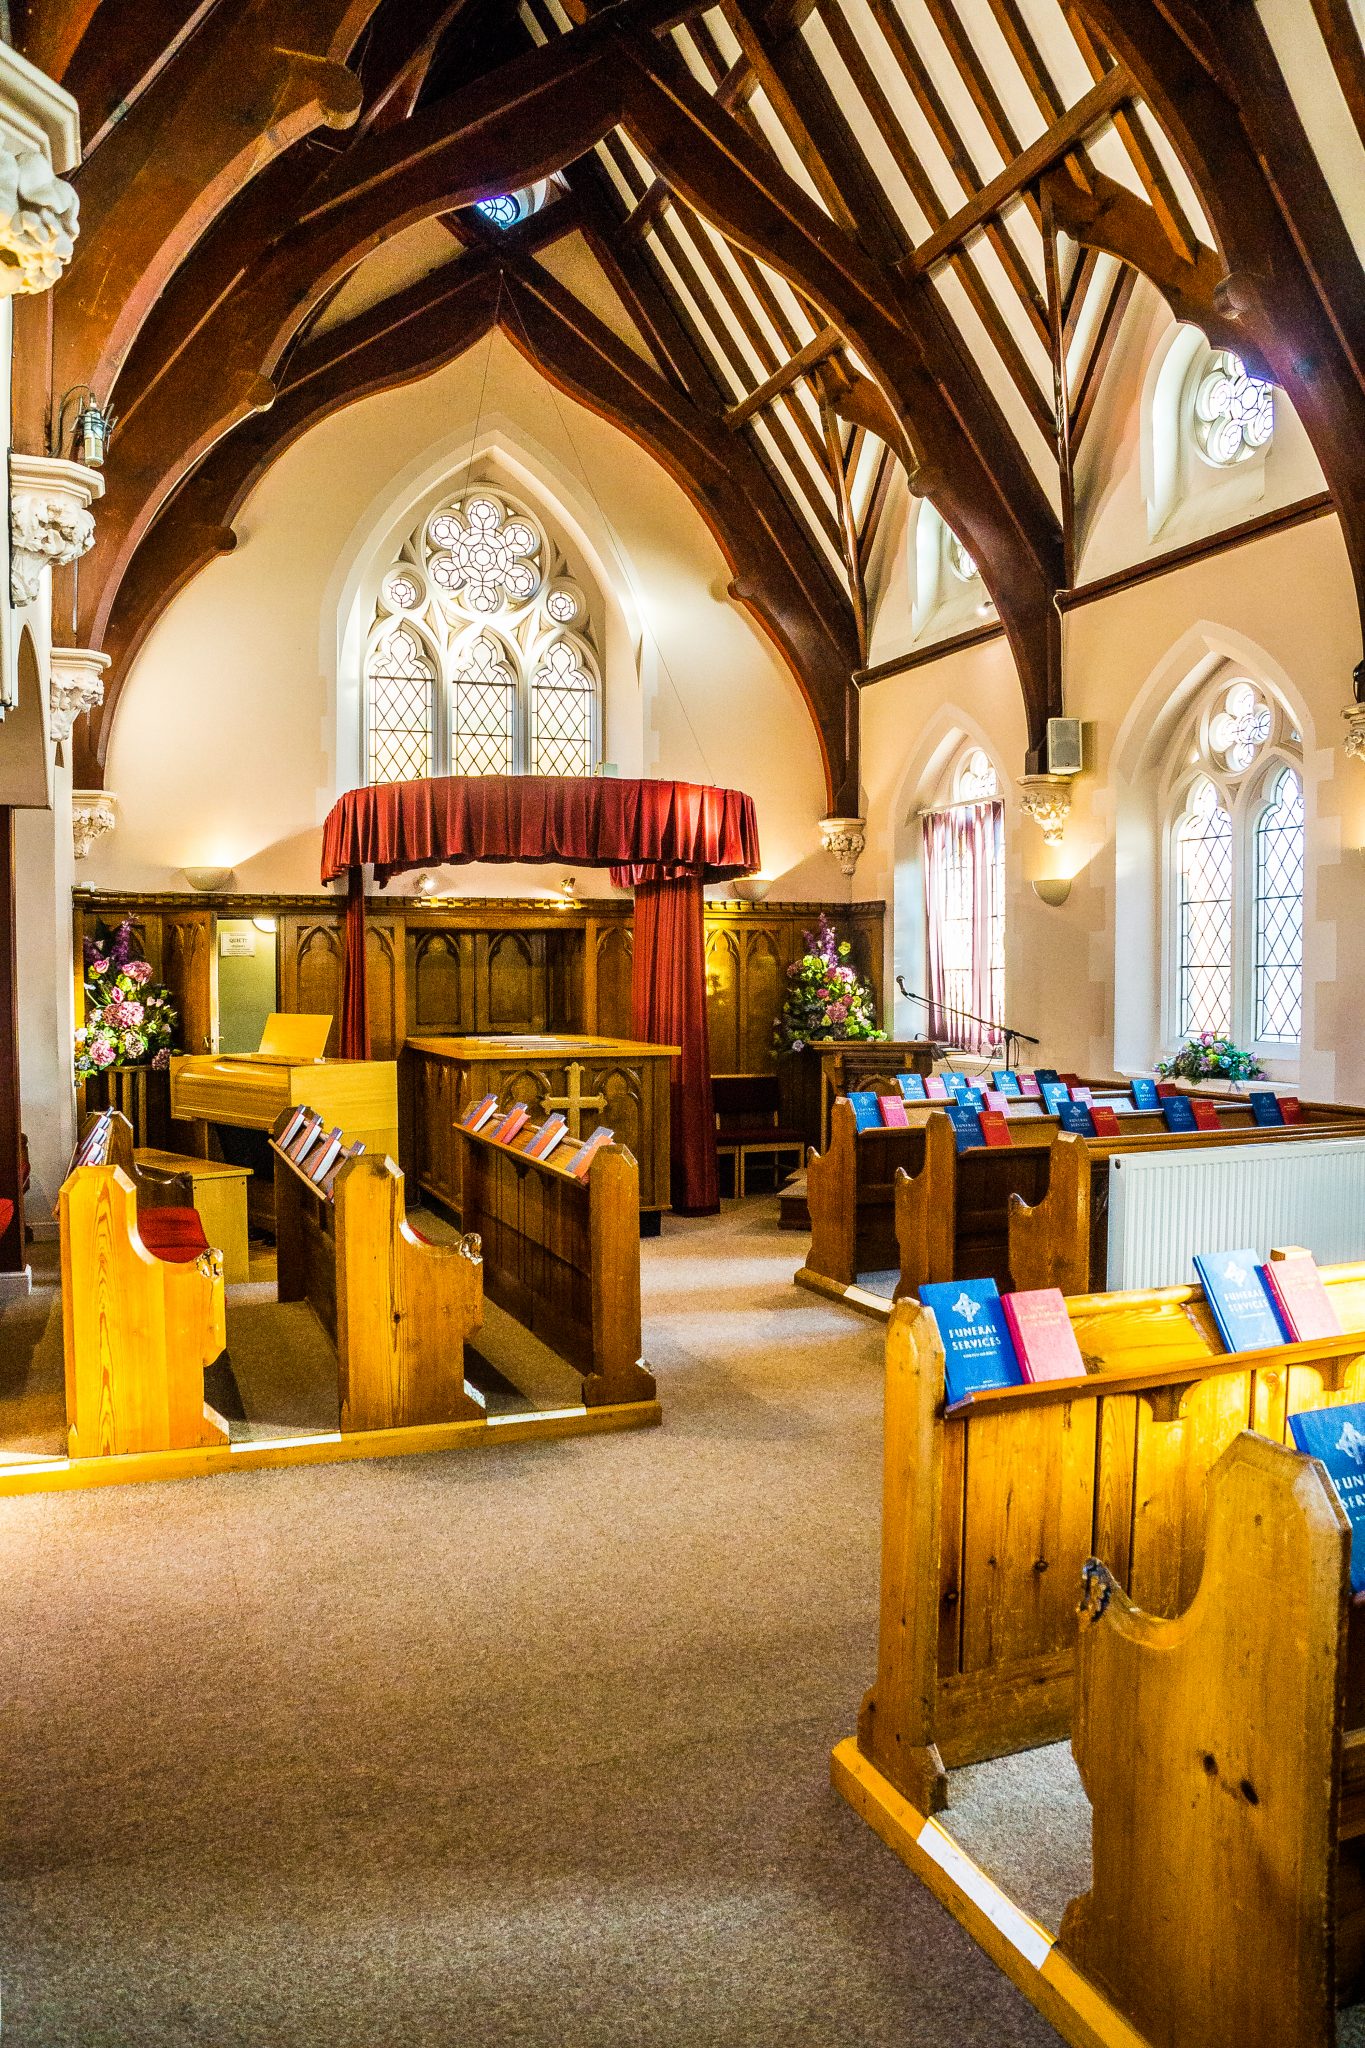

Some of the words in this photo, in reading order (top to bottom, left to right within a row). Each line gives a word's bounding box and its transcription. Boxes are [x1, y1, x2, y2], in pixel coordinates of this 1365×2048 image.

[1223, 1289, 1265, 1302] FUNERAL
[1227, 1300, 1269, 1312] SERVICES
[948, 1324, 997, 1339] FUNERAL
[951, 1336, 1001, 1351] SERVICES
[1334, 1473, 1365, 1491] FUN
[1341, 1493, 1365, 1510] SER
